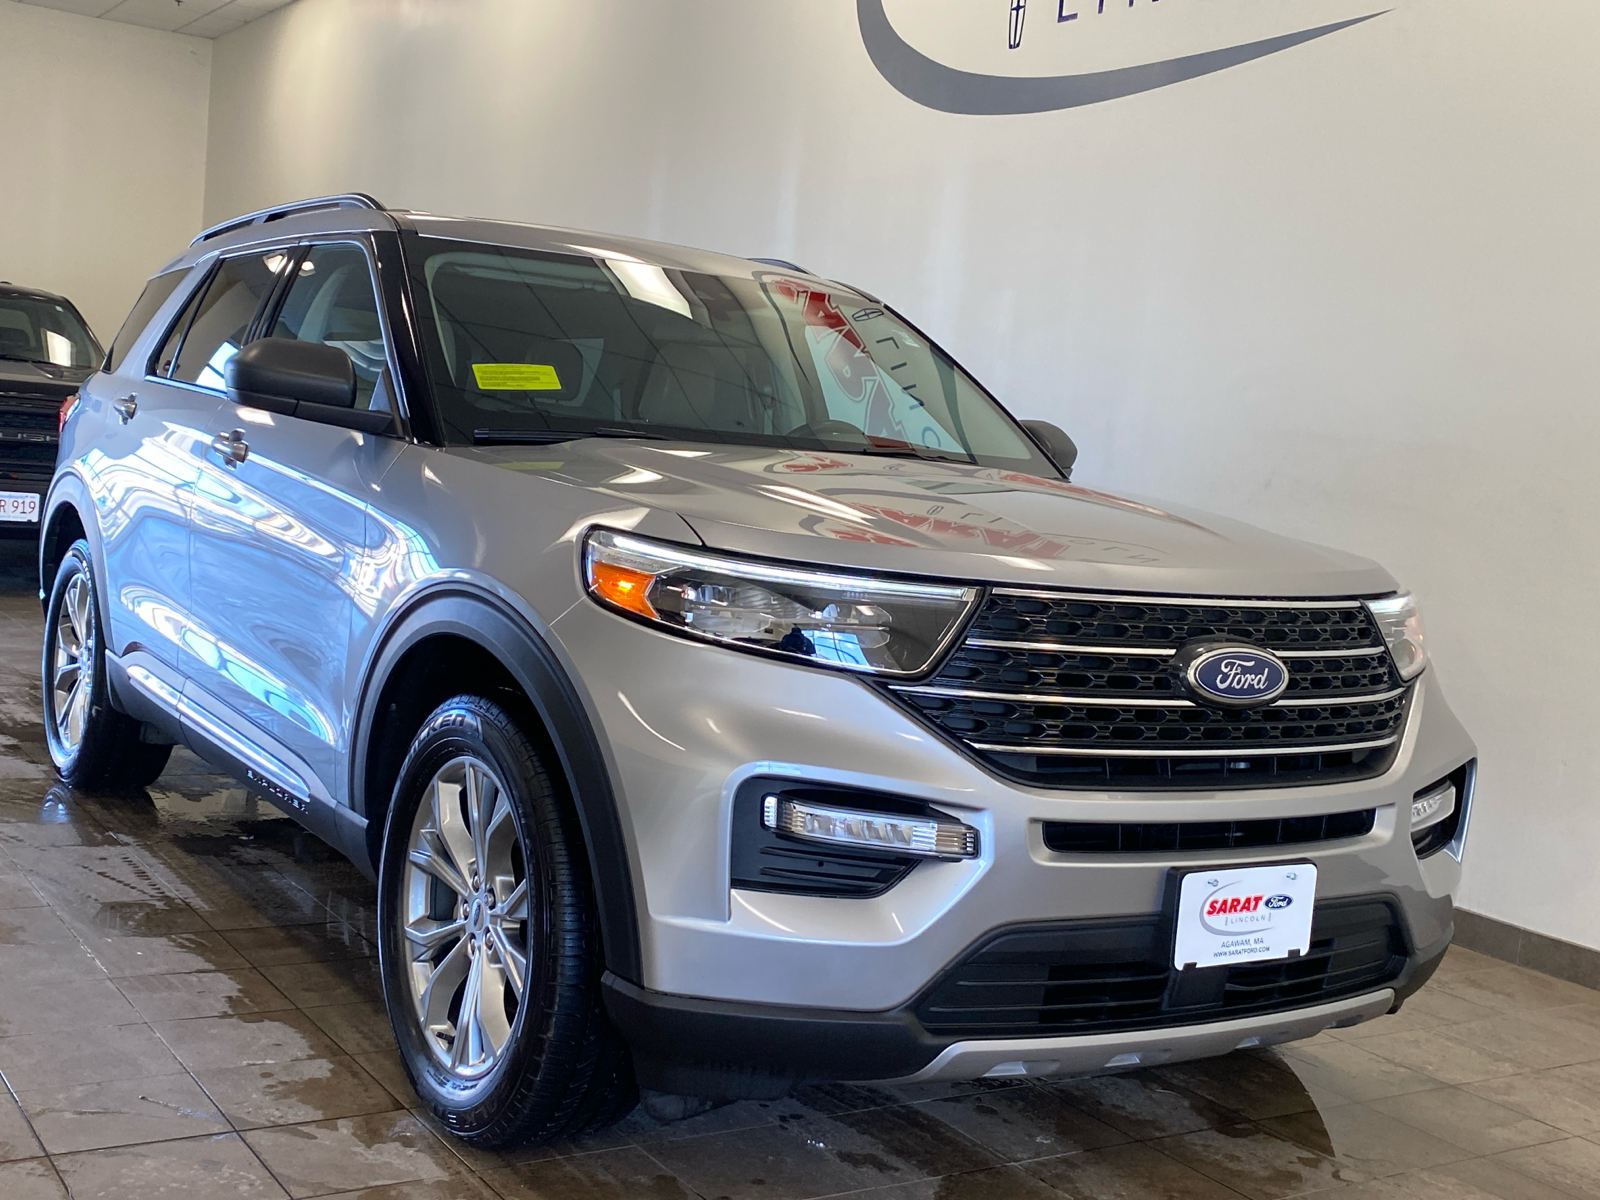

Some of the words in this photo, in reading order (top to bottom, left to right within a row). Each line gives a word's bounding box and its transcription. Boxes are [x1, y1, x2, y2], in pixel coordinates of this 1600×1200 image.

[12, 500, 36, 514] 919
[1216, 659, 1268, 689] Ford
[1206, 895, 1263, 916] SARAT
[1268, 896, 1289, 908] Ford
[1230, 915, 1266, 924] LINCOLN
[1221, 938, 1252, 948] AGAWAM,
[1254, 937, 1264, 945] MA
[1213, 946, 1270, 957] WWW.SARATFORD.COM
